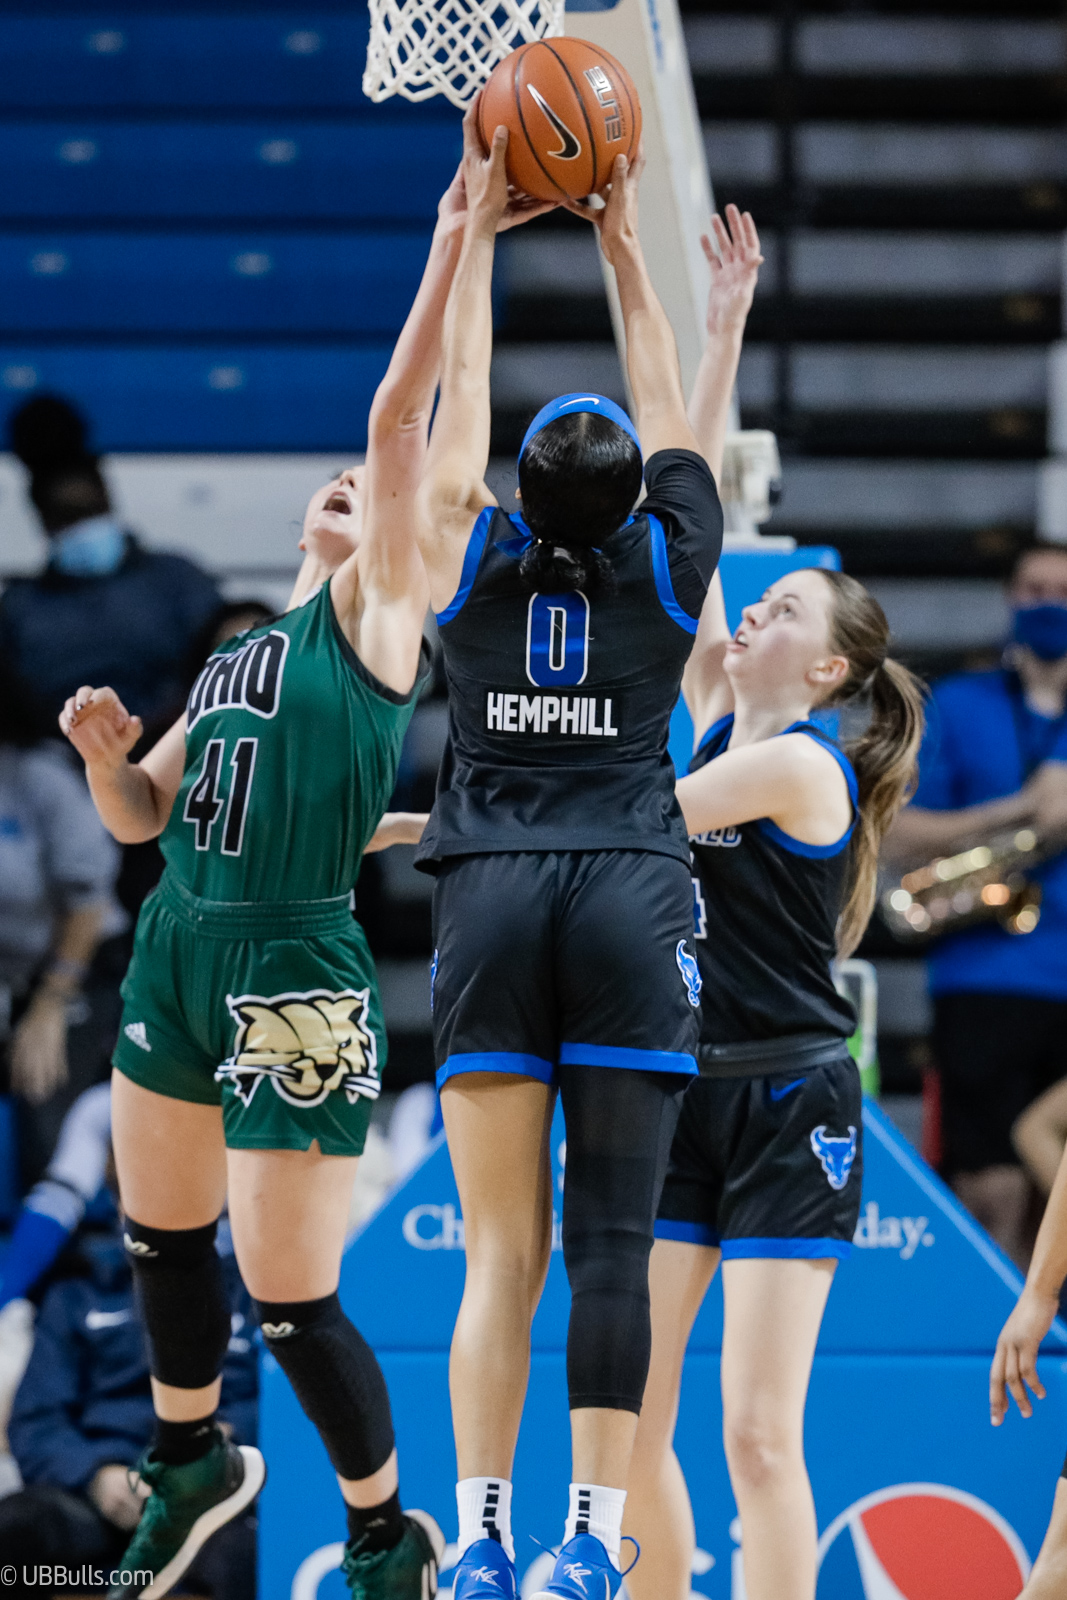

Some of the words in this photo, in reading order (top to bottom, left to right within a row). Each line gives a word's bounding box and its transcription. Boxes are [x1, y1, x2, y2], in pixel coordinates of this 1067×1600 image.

[583, 66, 622, 143] ELITE
[525, 588, 591, 688] 0
[486, 691, 619, 737] HEMPHILL
[182, 737, 259, 857] 41
